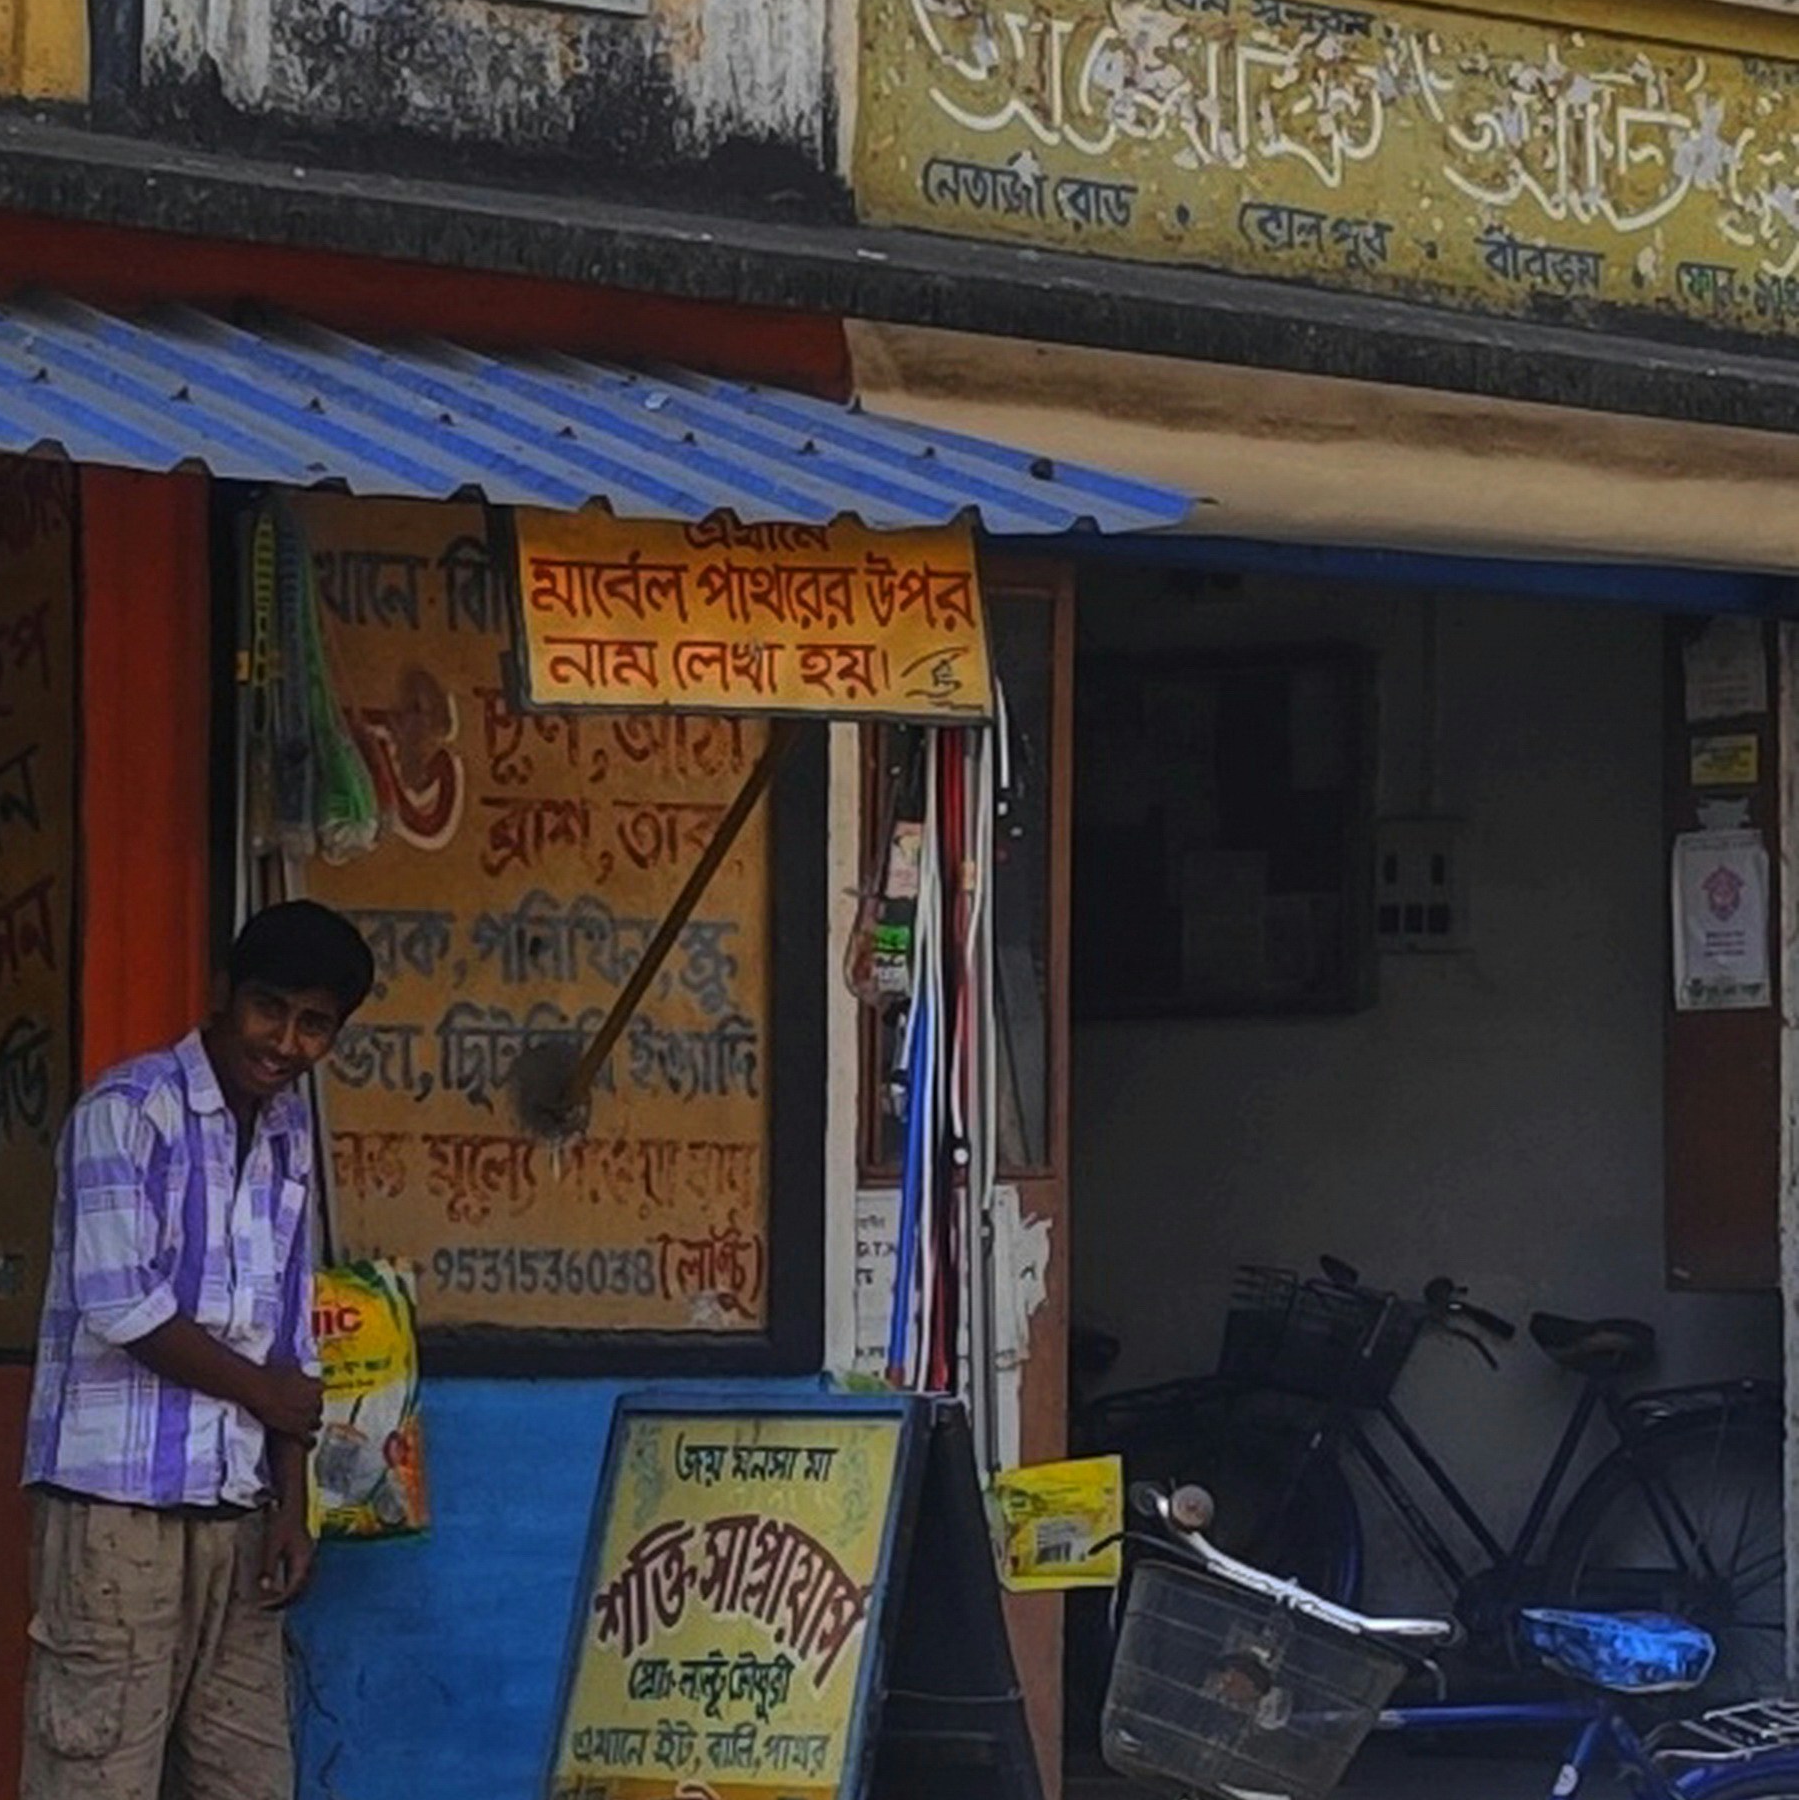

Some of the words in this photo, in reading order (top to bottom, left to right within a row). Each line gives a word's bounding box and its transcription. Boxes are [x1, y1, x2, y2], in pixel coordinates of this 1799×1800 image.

[529, 550, 690, 624] মার্বেল
[695, 556, 855, 631] পাথরের
[864, 550, 977, 632] উপর
[543, 635, 659, 690] নাম
[672, 637, 786, 695] লেখা
[802, 1447, 841, 1483] মা
[594, 1519, 698, 1659] শক্তি
